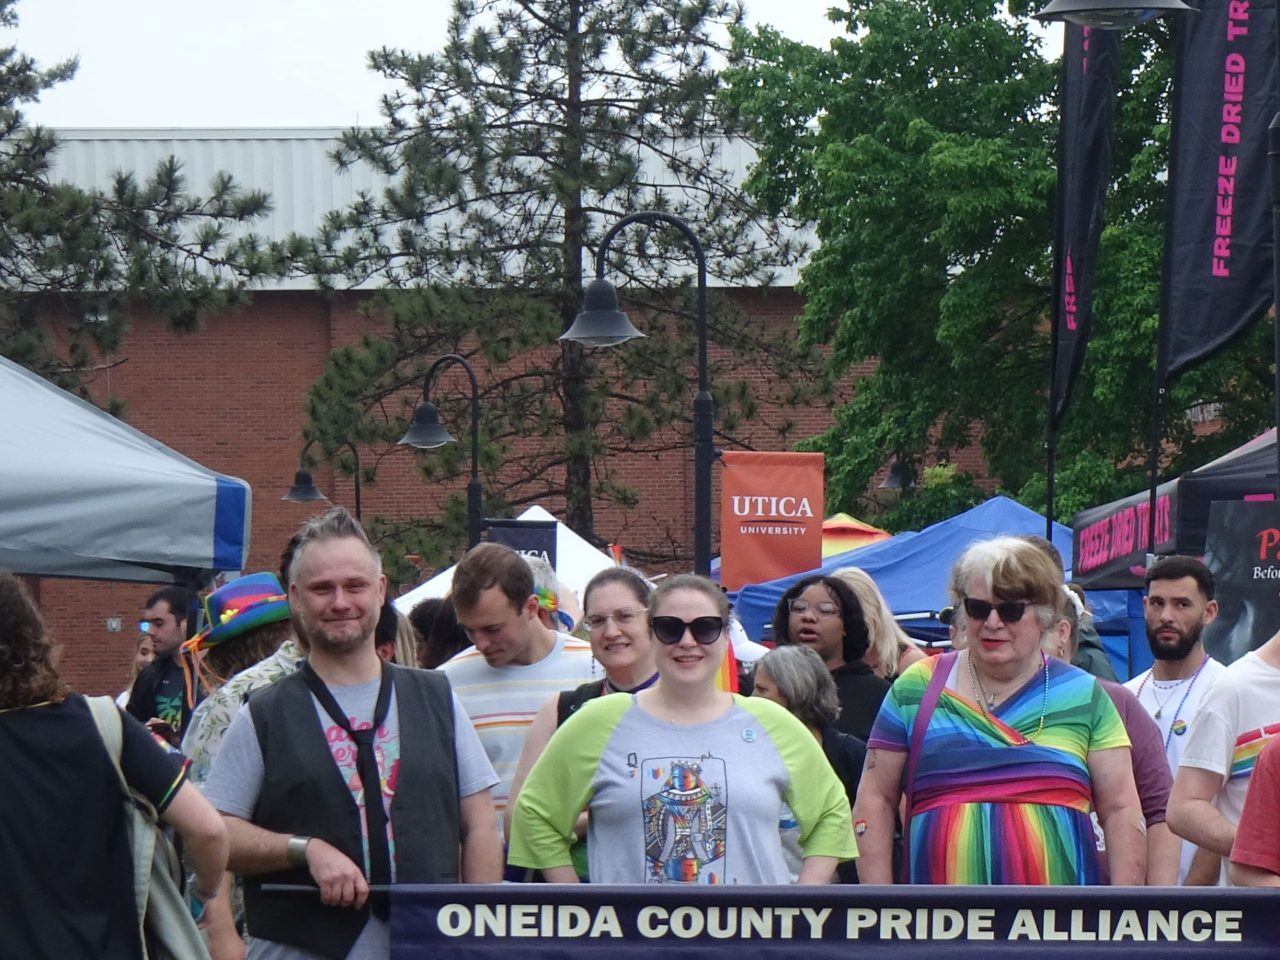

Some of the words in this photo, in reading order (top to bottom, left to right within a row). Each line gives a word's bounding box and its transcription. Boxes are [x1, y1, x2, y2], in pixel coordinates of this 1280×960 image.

[1221, 53, 1246, 144] DRIED
[1212, 156, 1237, 277] FREEZE
[732, 496, 814, 517] UTICA
[740, 526, 807, 535] UNIVERSITY
[437, 903, 623, 938] ONEIDA
[637, 906, 831, 939] COUNTY
[846, 908, 995, 940] PRIDE
[1007, 909, 1243, 942] ALLIANCE
